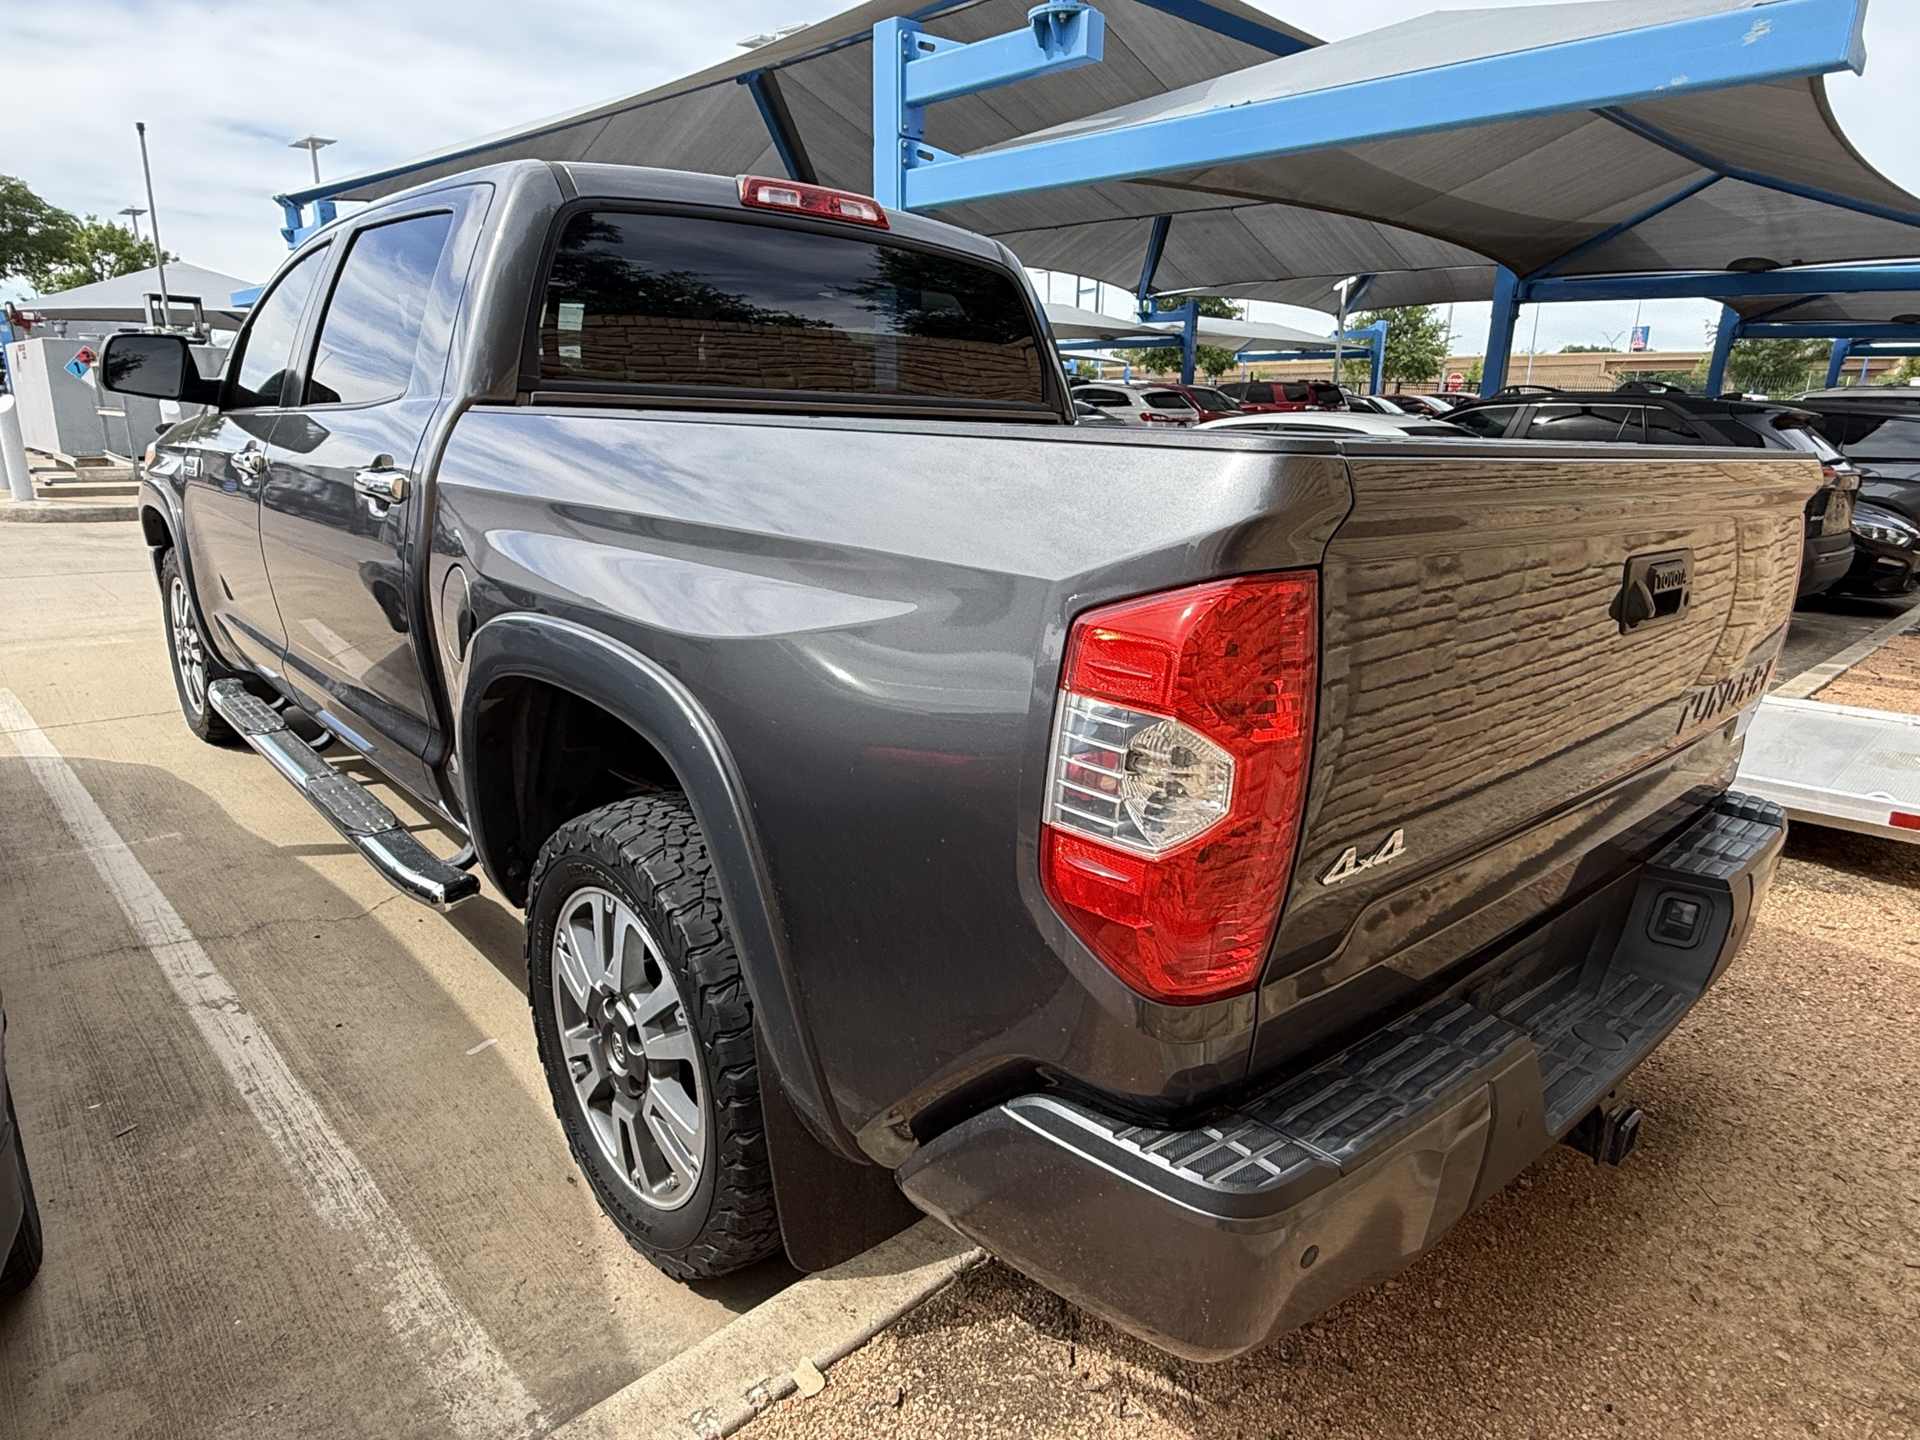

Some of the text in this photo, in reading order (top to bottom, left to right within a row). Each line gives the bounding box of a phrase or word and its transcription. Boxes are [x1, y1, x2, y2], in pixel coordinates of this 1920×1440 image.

[73, 361, 82, 374] 1
[1655, 569, 1687, 590] TOYOTA
[1676, 659, 1772, 735] TUNDRA
[1315, 827, 1407, 886] 4x4
